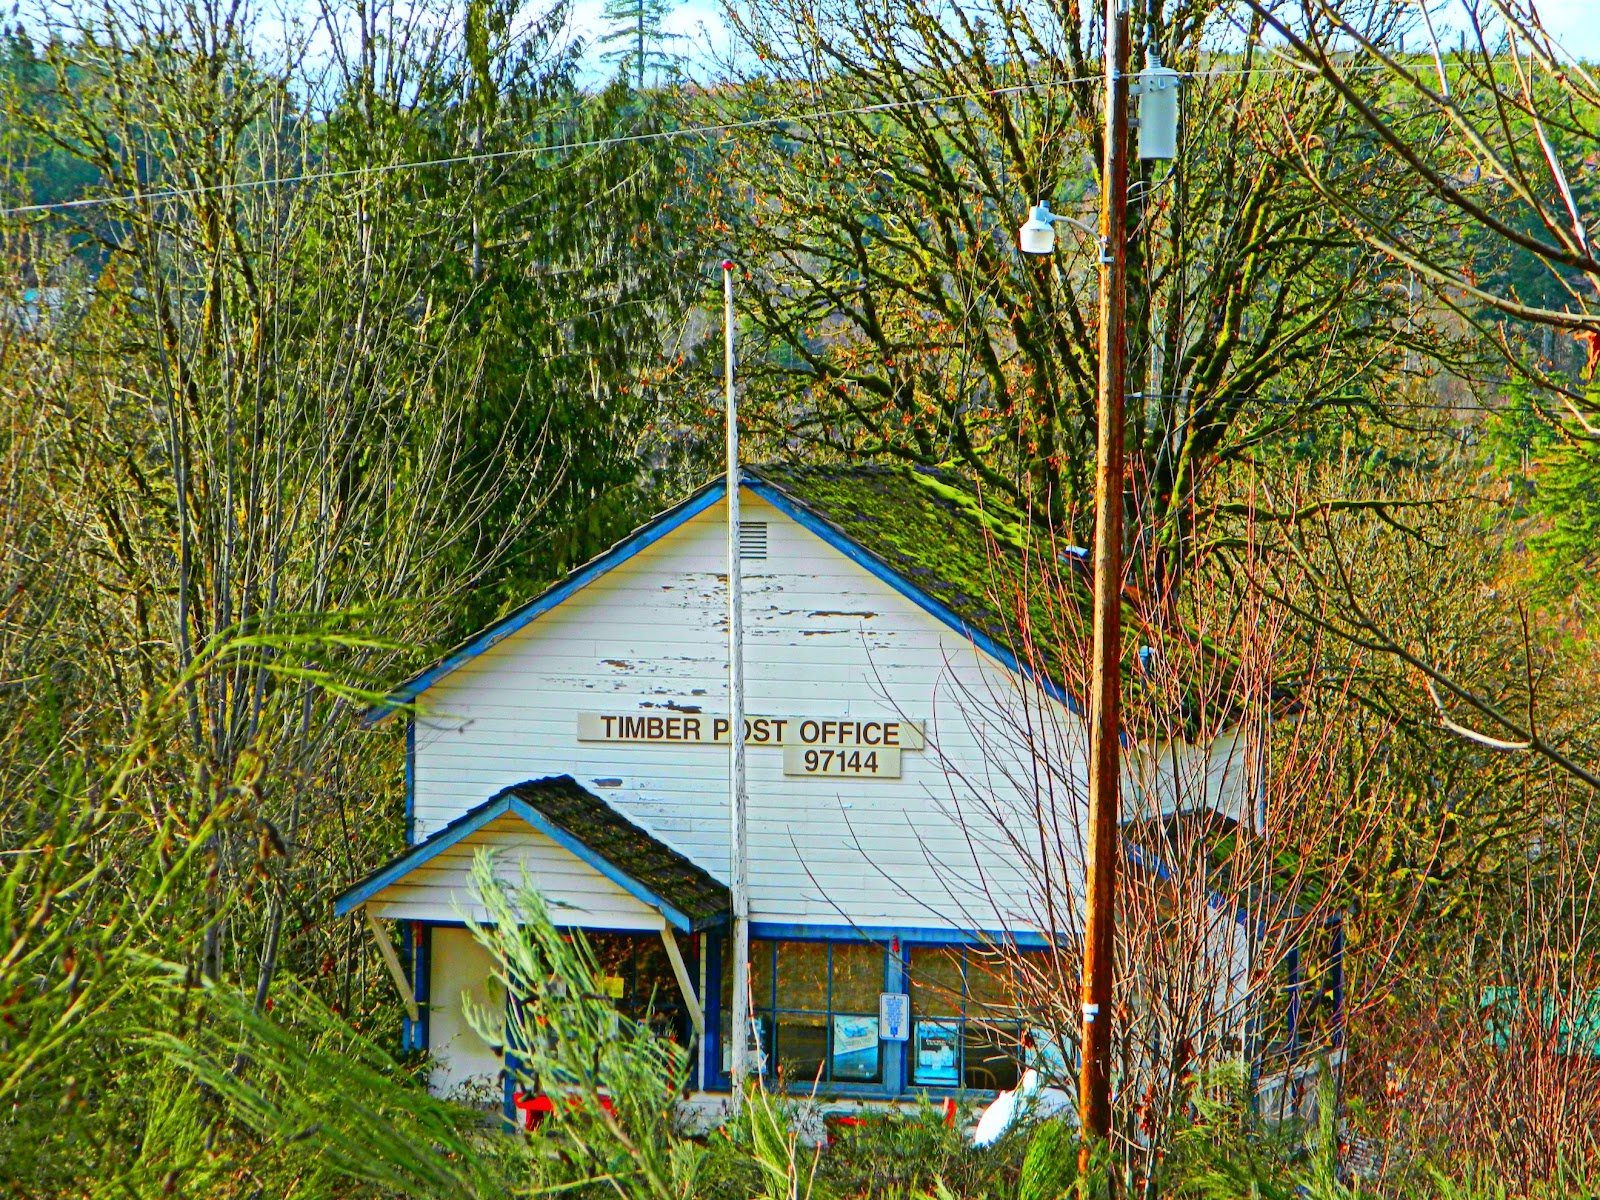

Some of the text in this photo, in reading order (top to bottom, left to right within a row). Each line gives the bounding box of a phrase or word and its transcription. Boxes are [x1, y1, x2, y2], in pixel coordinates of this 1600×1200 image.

[601, 716, 701, 740] TIMBER
[799, 720, 900, 746] OFFICE
[804, 749, 879, 773] 97144
